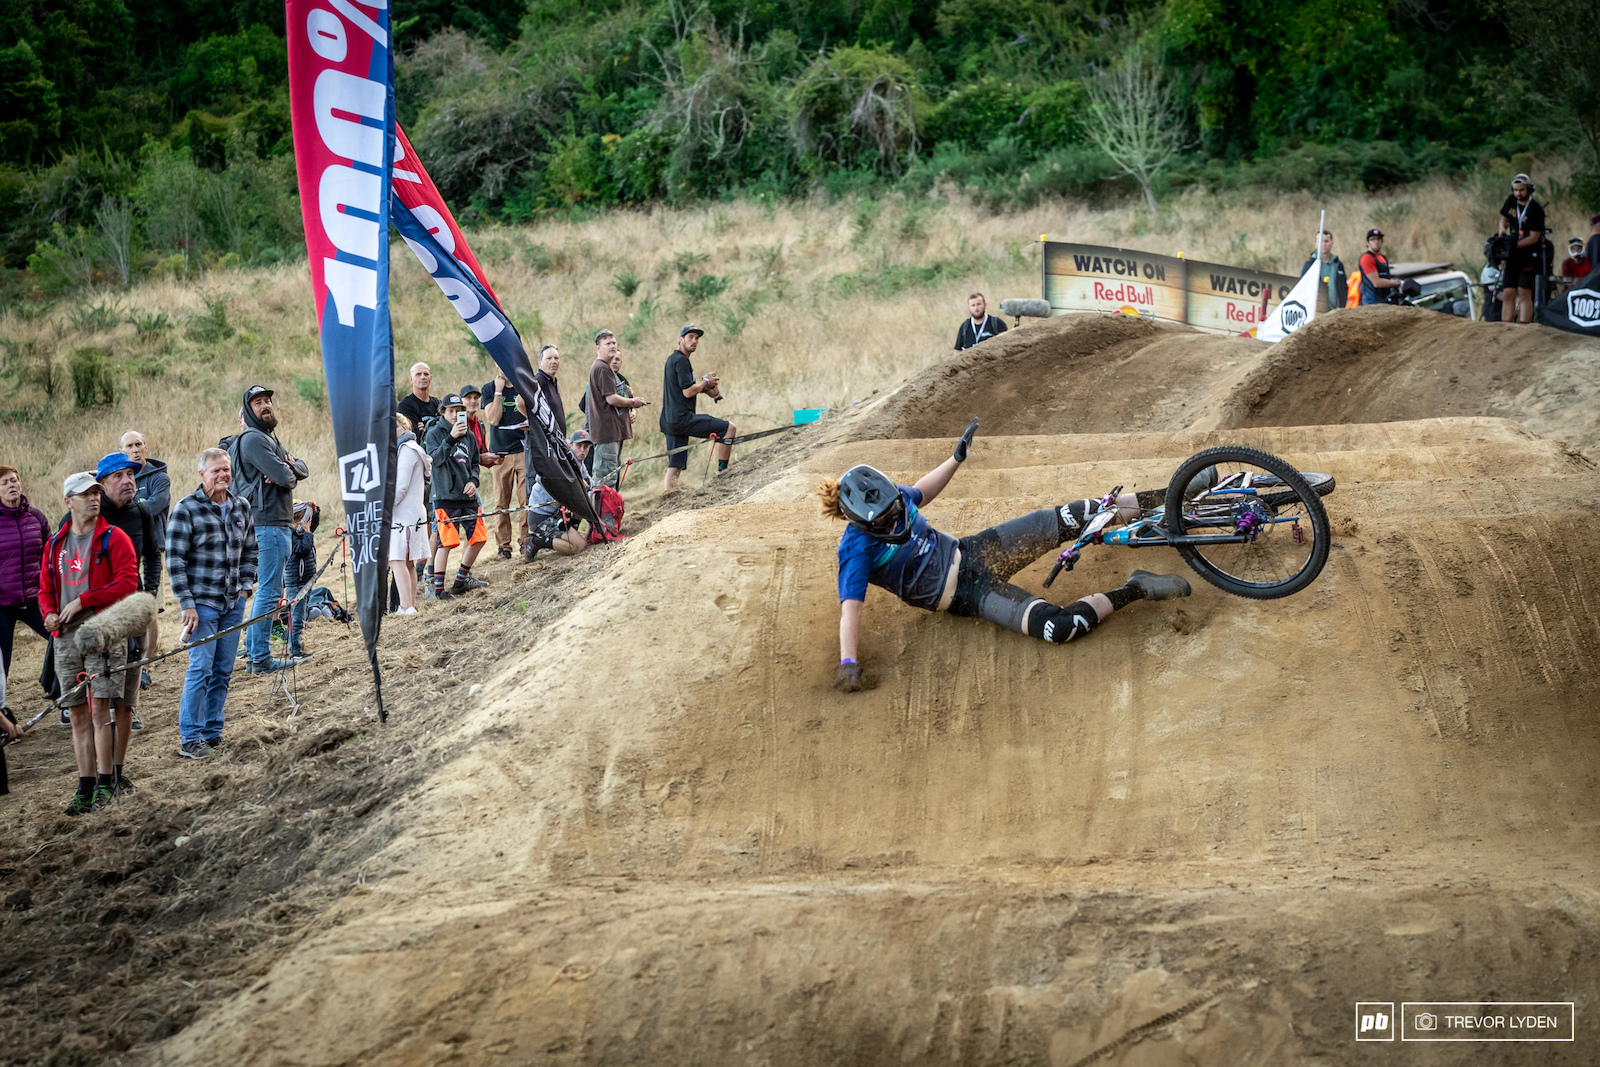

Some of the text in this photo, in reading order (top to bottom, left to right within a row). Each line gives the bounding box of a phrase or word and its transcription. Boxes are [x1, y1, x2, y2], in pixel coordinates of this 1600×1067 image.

[1073, 254, 1166, 281] WATCH ON
[1094, 281, 1154, 306] Red Bull
[1209, 274, 1272, 300] WATCH
[1226, 302, 1255, 324] Red
[1574, 297, 1600, 319] 100%
